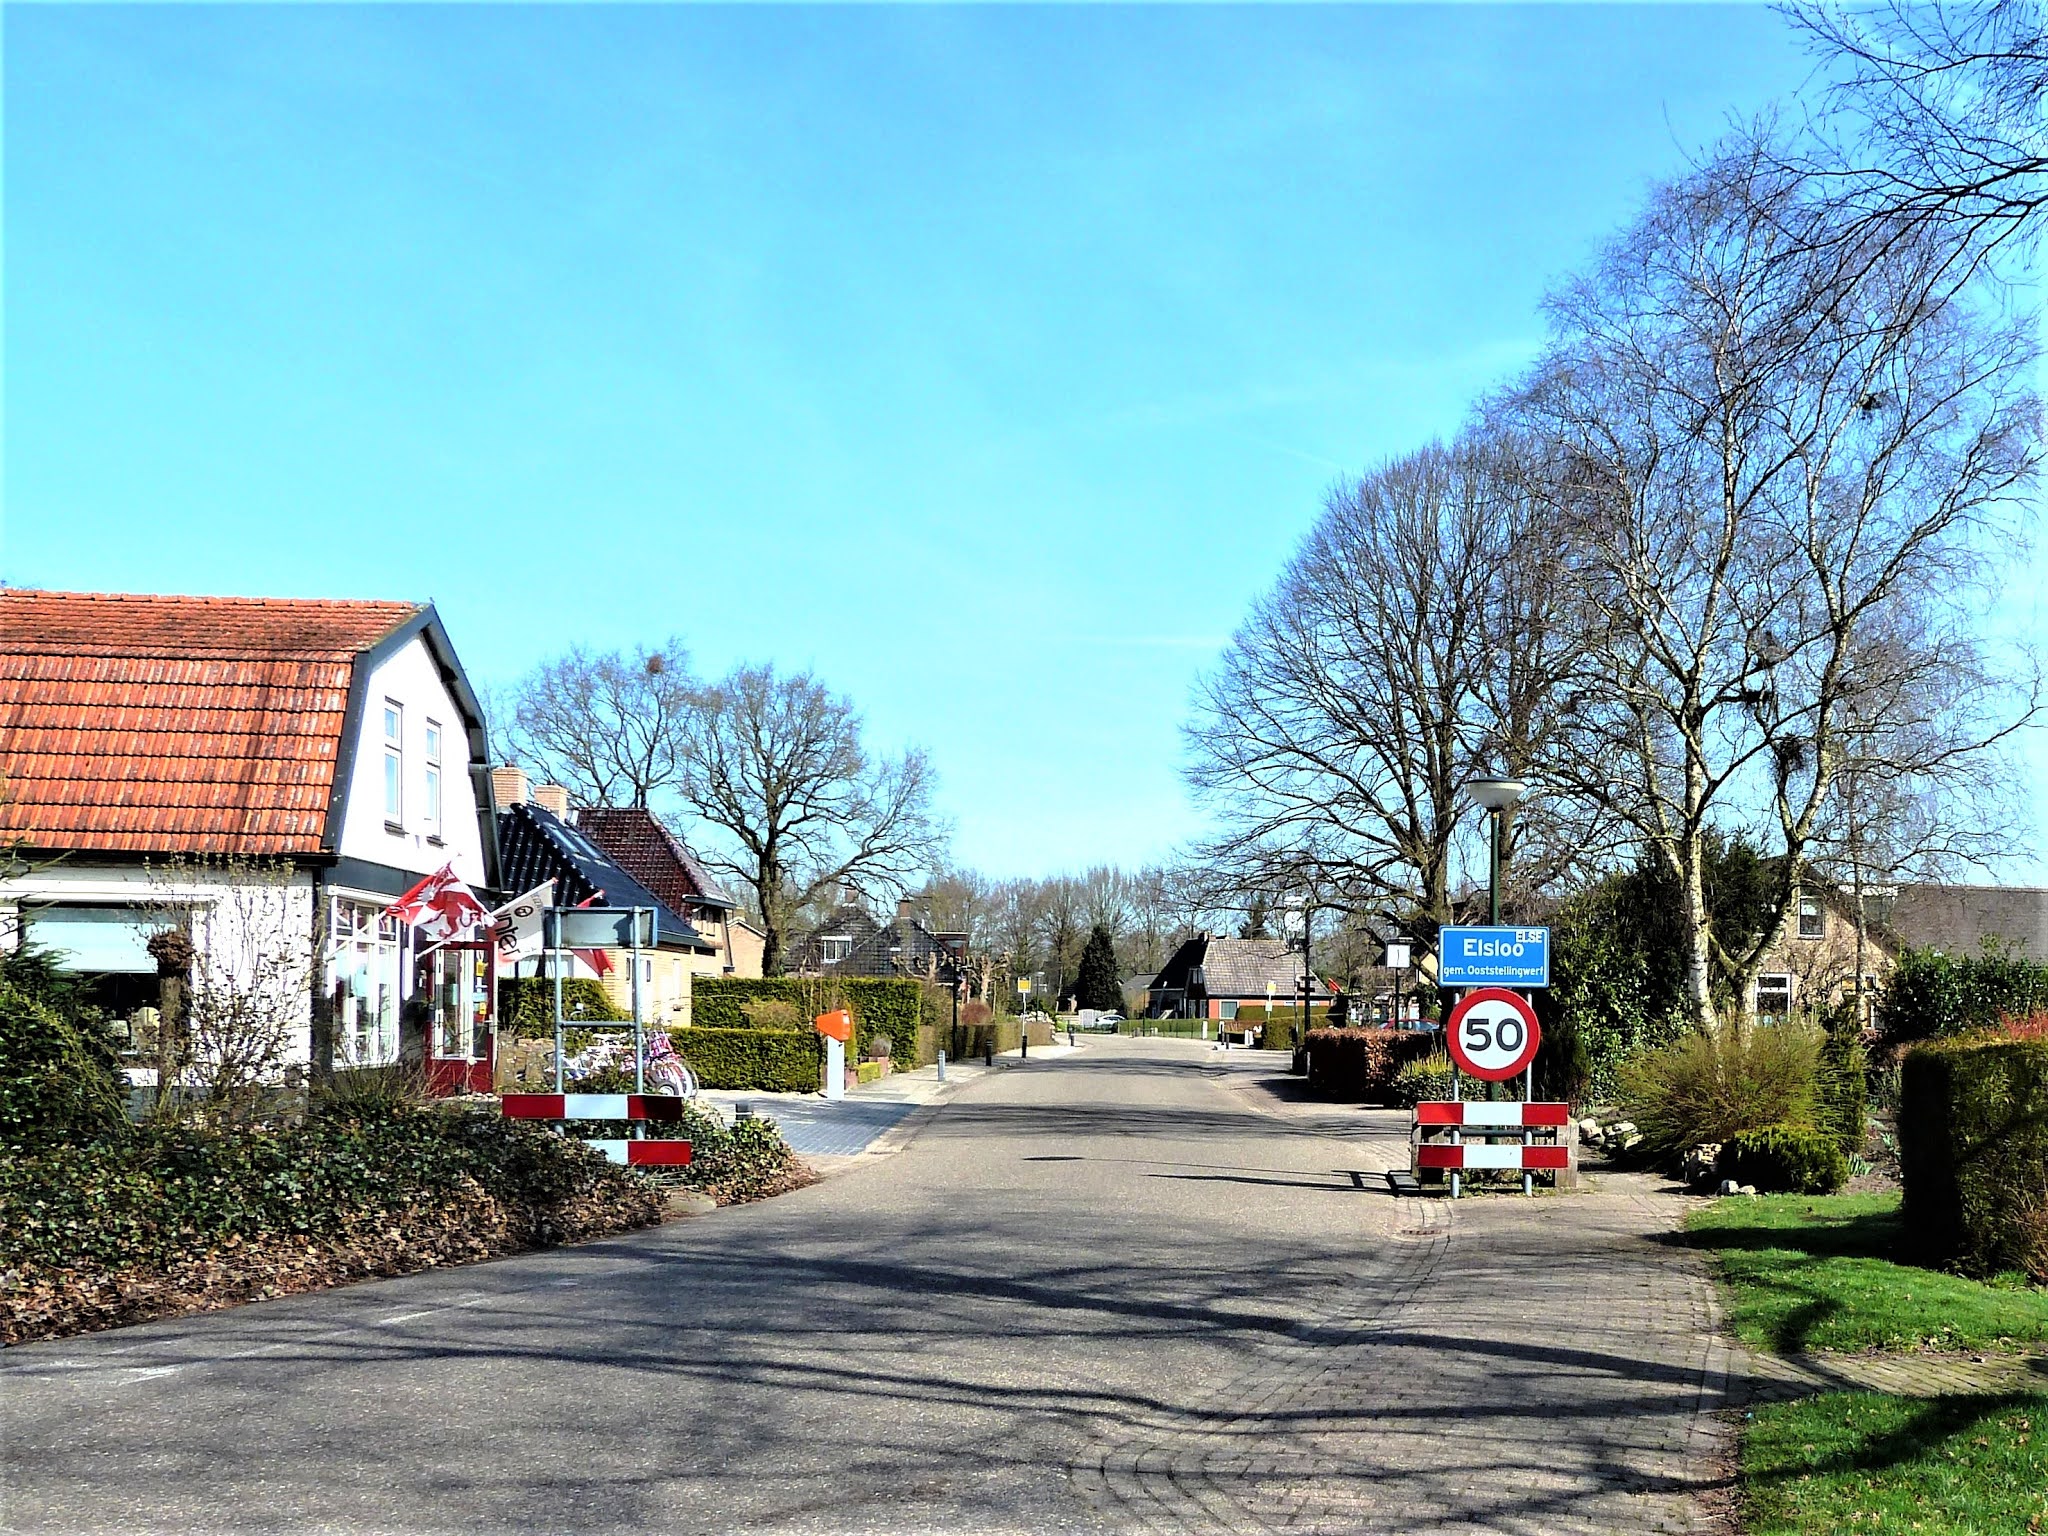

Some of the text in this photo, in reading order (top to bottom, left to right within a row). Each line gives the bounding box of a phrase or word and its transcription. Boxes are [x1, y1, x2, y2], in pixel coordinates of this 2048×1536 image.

[1515, 930, 1543, 943] ELSE
[1463, 938, 1525, 957] Elsloo
[1443, 965, 1544, 978] gem. Ooststellingwerf
[1465, 1018, 1523, 1052] 50
